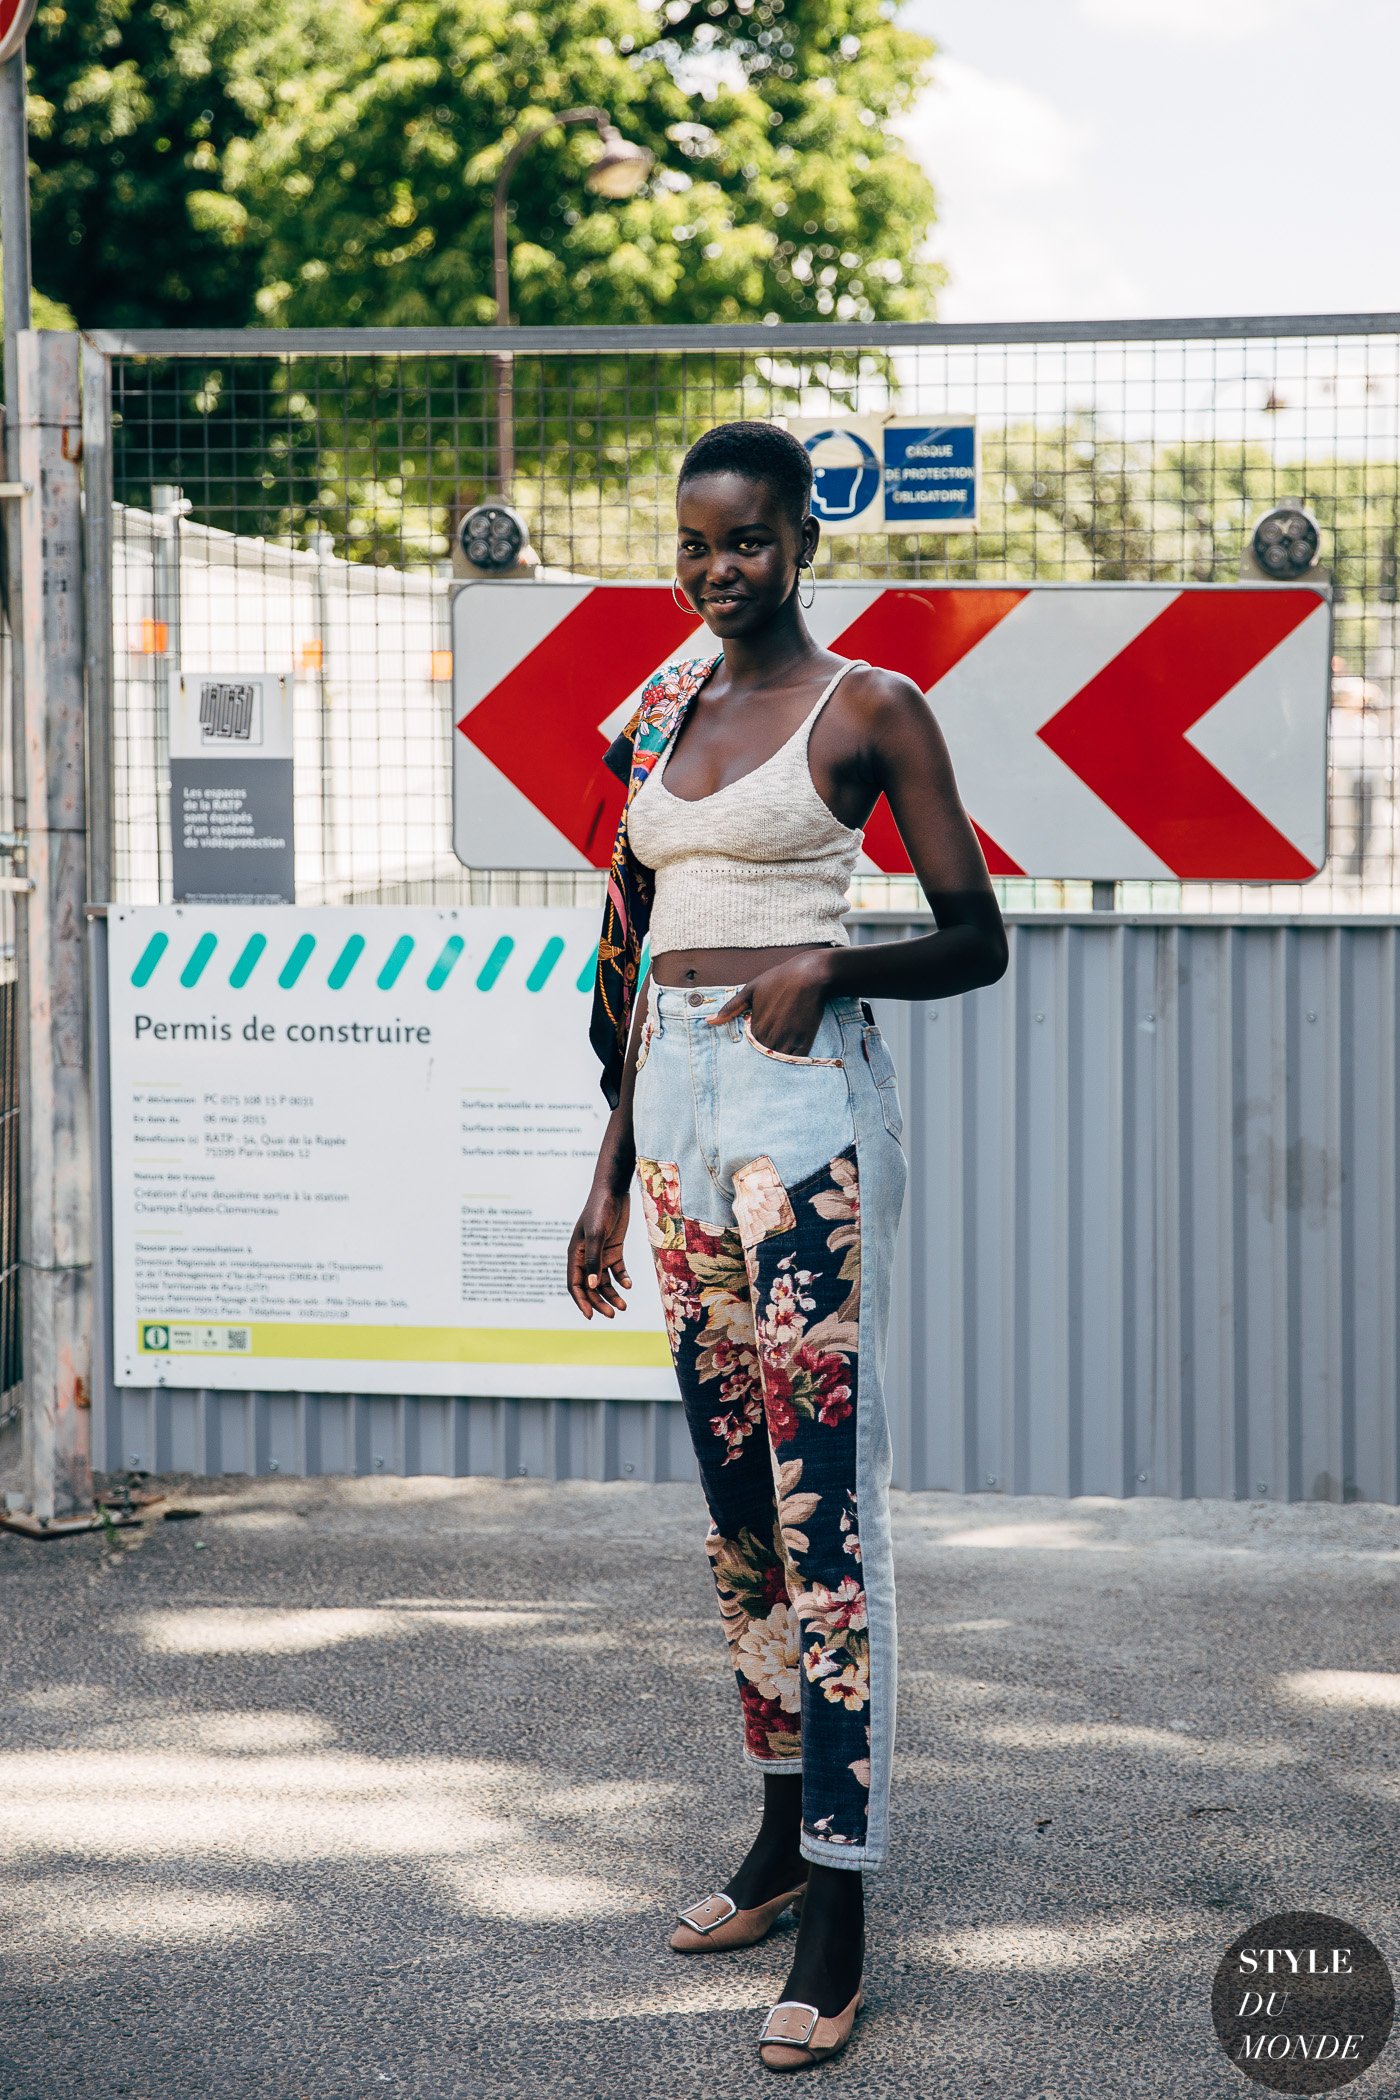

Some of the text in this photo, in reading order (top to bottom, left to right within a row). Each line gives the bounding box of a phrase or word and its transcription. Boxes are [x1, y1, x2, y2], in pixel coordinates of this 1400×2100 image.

[906, 445, 953, 458] CASQUE
[886, 467, 975, 481] DE PROTECTION
[893, 489, 967, 503] OBLIGATOIRE
[183, 787, 247, 801] Les espaces
[183, 799, 243, 811] de la RATP
[184, 812, 253, 825] sont équipés
[184, 824, 255, 837] d'un système
[184, 837, 199, 848] de
[135, 1015, 431, 1044] Permis de construire
